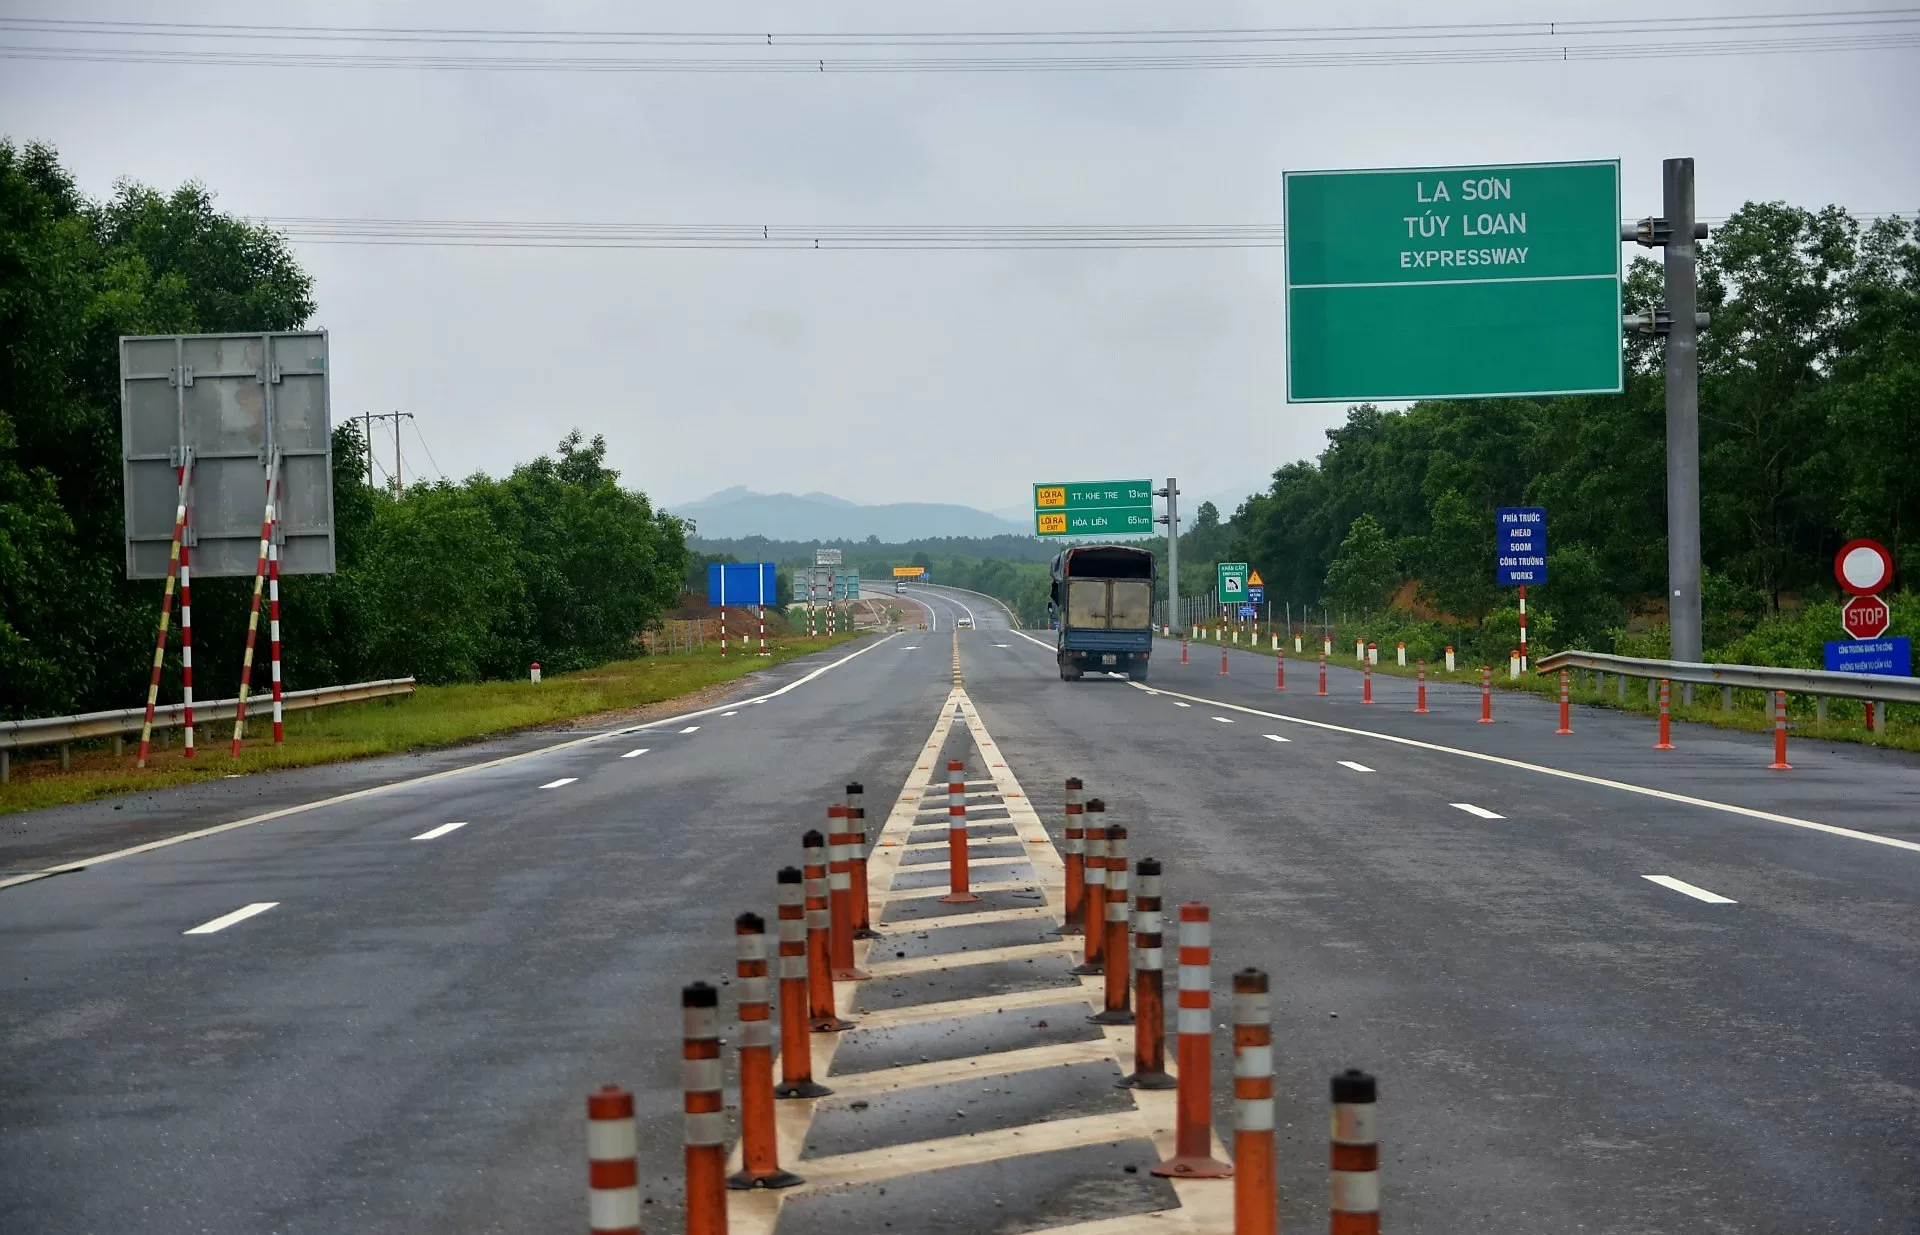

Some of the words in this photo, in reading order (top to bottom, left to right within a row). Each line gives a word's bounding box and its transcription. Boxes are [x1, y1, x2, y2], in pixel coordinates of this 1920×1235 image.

[1417, 180, 1450, 203] LA
[1462, 176, 1511, 201] SƠN
[1403, 210, 1450, 238] TÚY
[1463, 212, 1526, 236] LOAN
[1400, 247, 1529, 268] EXPRESSWAY
[1086, 492, 1100, 500] KHE
[1072, 517, 1088, 526] HÒA
[1091, 516, 1108, 526] LIÊN
[1502, 512, 1518, 522] PHÍA
[1519, 512, 1540, 522] TRƯỚC
[1510, 528, 1532, 537] AHEAD
[1510, 543, 1532, 552] 500M
[1500, 556, 1517, 566] CÔNG
[1519, 556, 1544, 566] TRƯỜNG
[1510, 572, 1533, 580] WORKS
[1849, 608, 1884, 626] STOP
